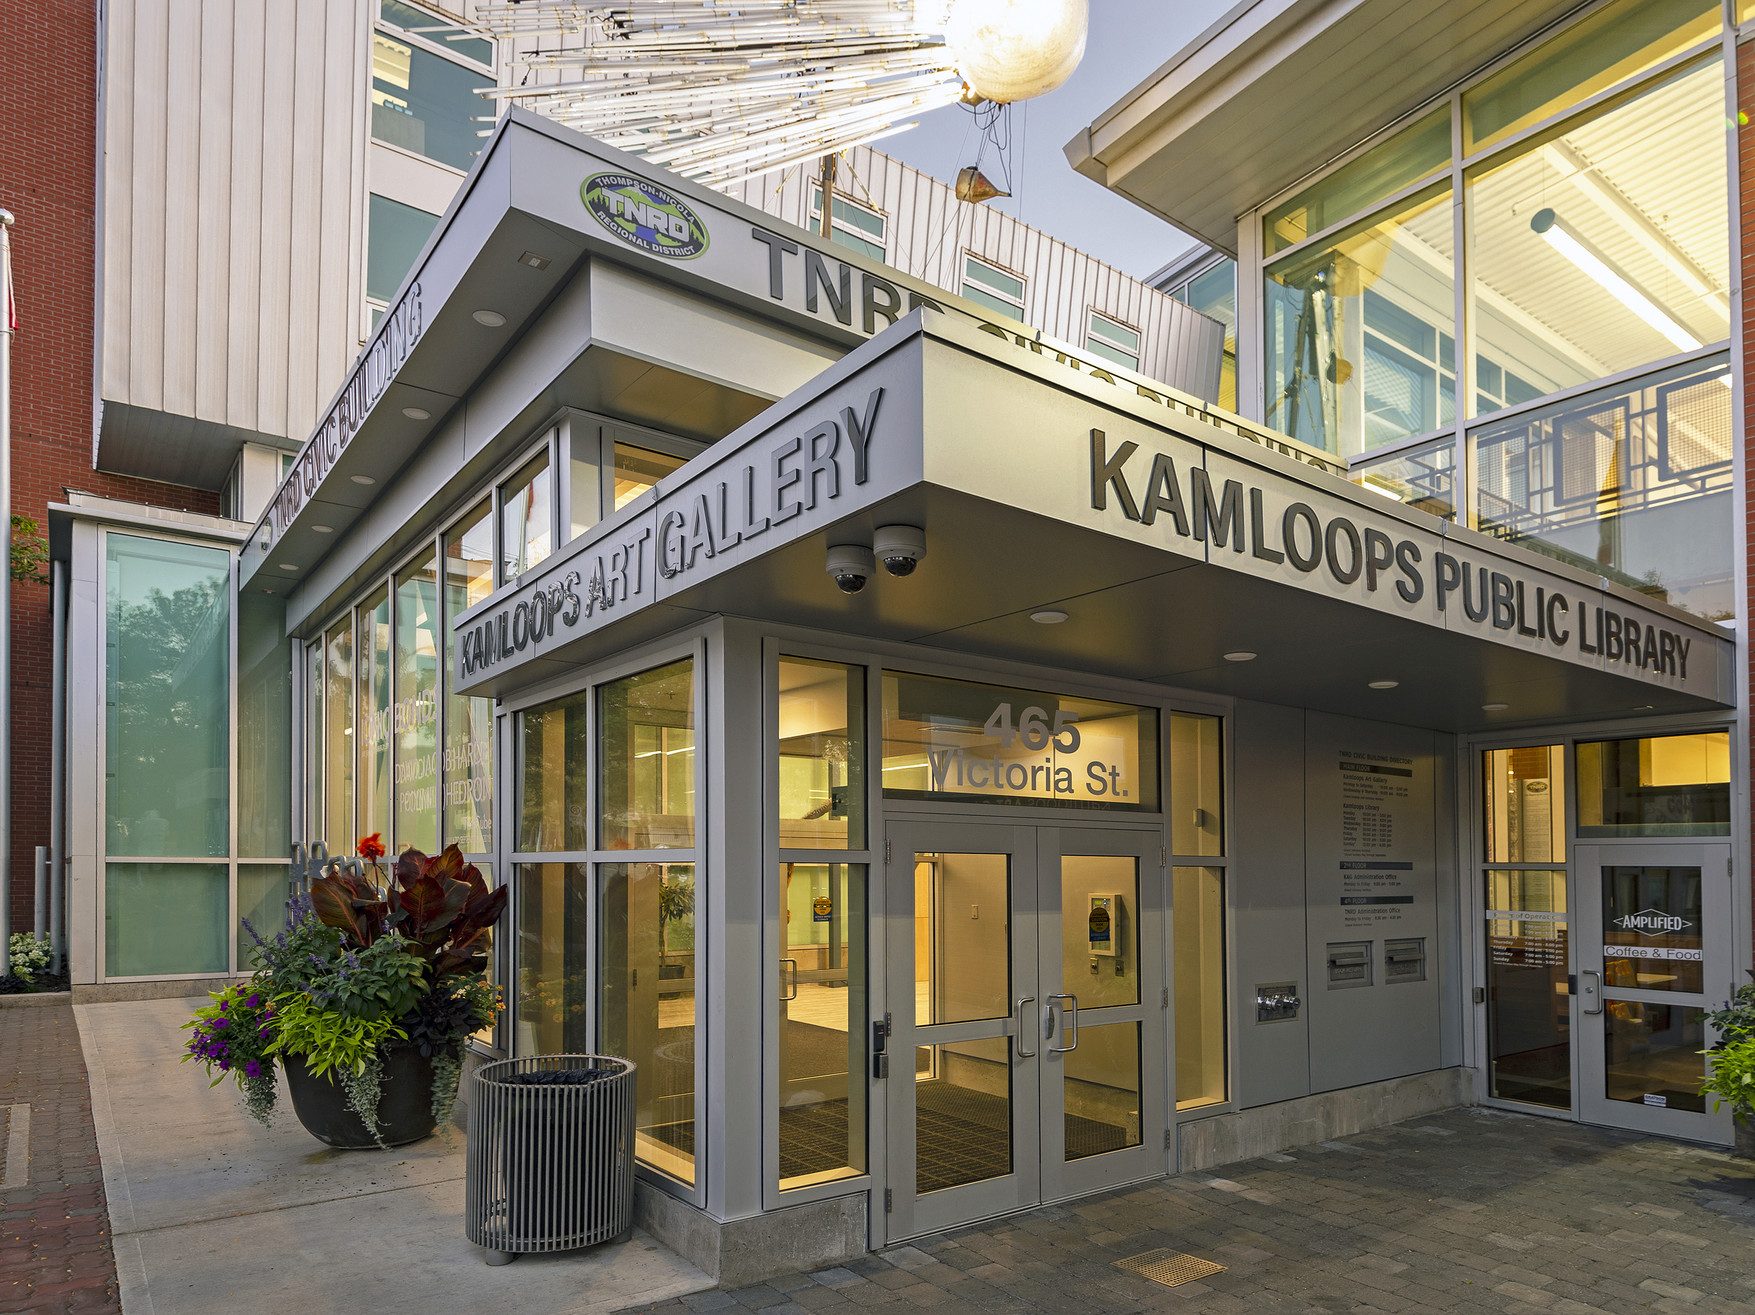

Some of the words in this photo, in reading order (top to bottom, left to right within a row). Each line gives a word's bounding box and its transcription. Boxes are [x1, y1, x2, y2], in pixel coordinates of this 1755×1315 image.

[595, 175, 695, 224] THOMPSON-NICOLA
[600, 187, 690, 243] TNRD
[596, 210, 650, 250] REGIONAL
[652, 242, 696, 257] DISTRICT
[751, 227, 945, 334] TNR
[303, 416, 337, 497] CIVIC
[338, 281, 422, 449] BUILDING
[461, 570, 581, 679] KAMLOOPS
[585, 527, 650, 618] ART
[657, 386, 885, 579] GALLERY
[1090, 427, 1426, 604] KAMLOOPS
[1436, 551, 1570, 647] PUBLIC
[1578, 591, 1692, 681] LIBRARY
[984, 702, 1081, 754] 465
[927, 749, 1075, 794] Victoria
[1086, 761, 1129, 797] St.
[1622, 914, 1682, 930] AMPLIFIED
[1606, 945, 1647, 957] Coffee
[1652, 948, 1661, 958] &
[1667, 949, 1701, 960] Food
